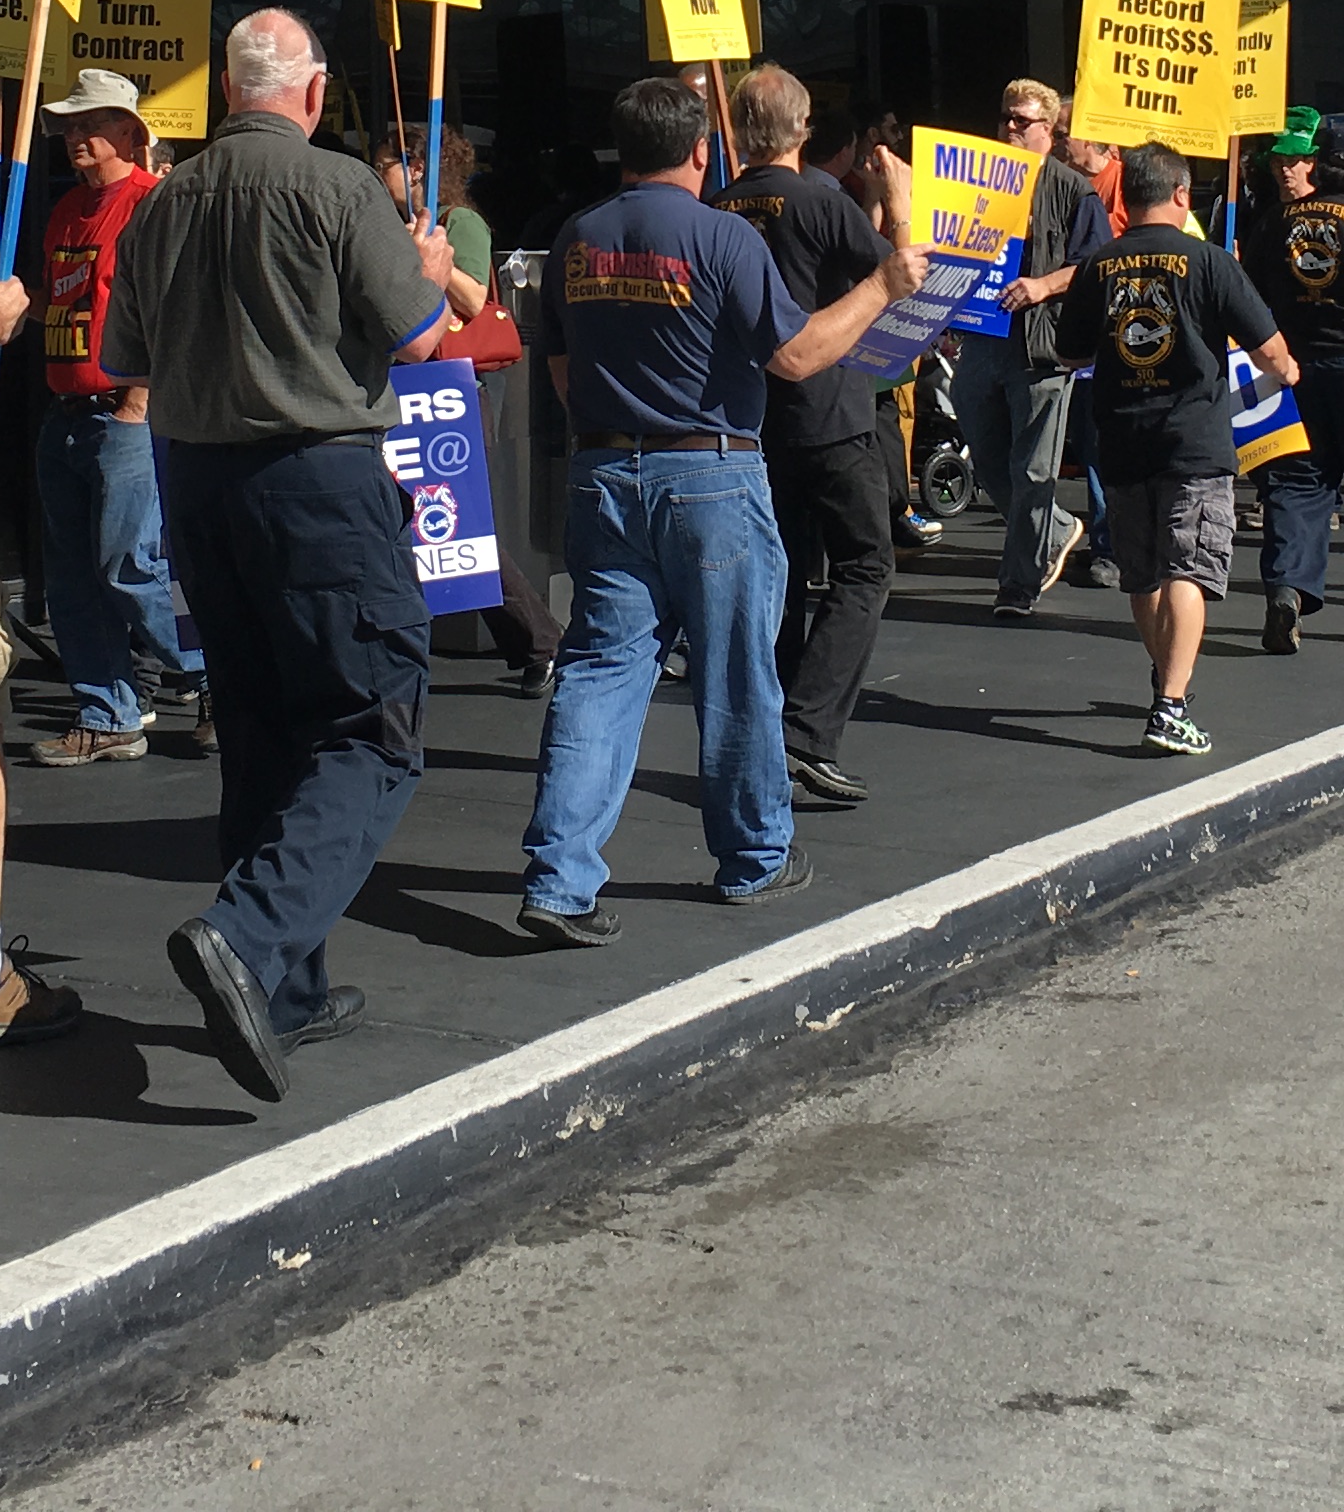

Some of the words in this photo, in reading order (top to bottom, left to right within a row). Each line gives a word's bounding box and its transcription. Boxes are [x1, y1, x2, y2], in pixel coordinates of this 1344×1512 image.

[72, 32, 184, 62] Contract
[1097, 17, 1219, 57] Profit$$$.
[1113, 51, 1149, 78] It's
[1156, 57, 1198, 86] Our
[1122, 83, 1183, 115] Turn.
[935, 143, 1028, 196] MILLIONS
[974, 193, 989, 215] for
[933, 210, 965, 248] UAL
[962, 218, 1004, 254] Execs
[588, 247, 691, 284] Teamsters
[1097, 253, 1189, 281] TEAMSTERS
